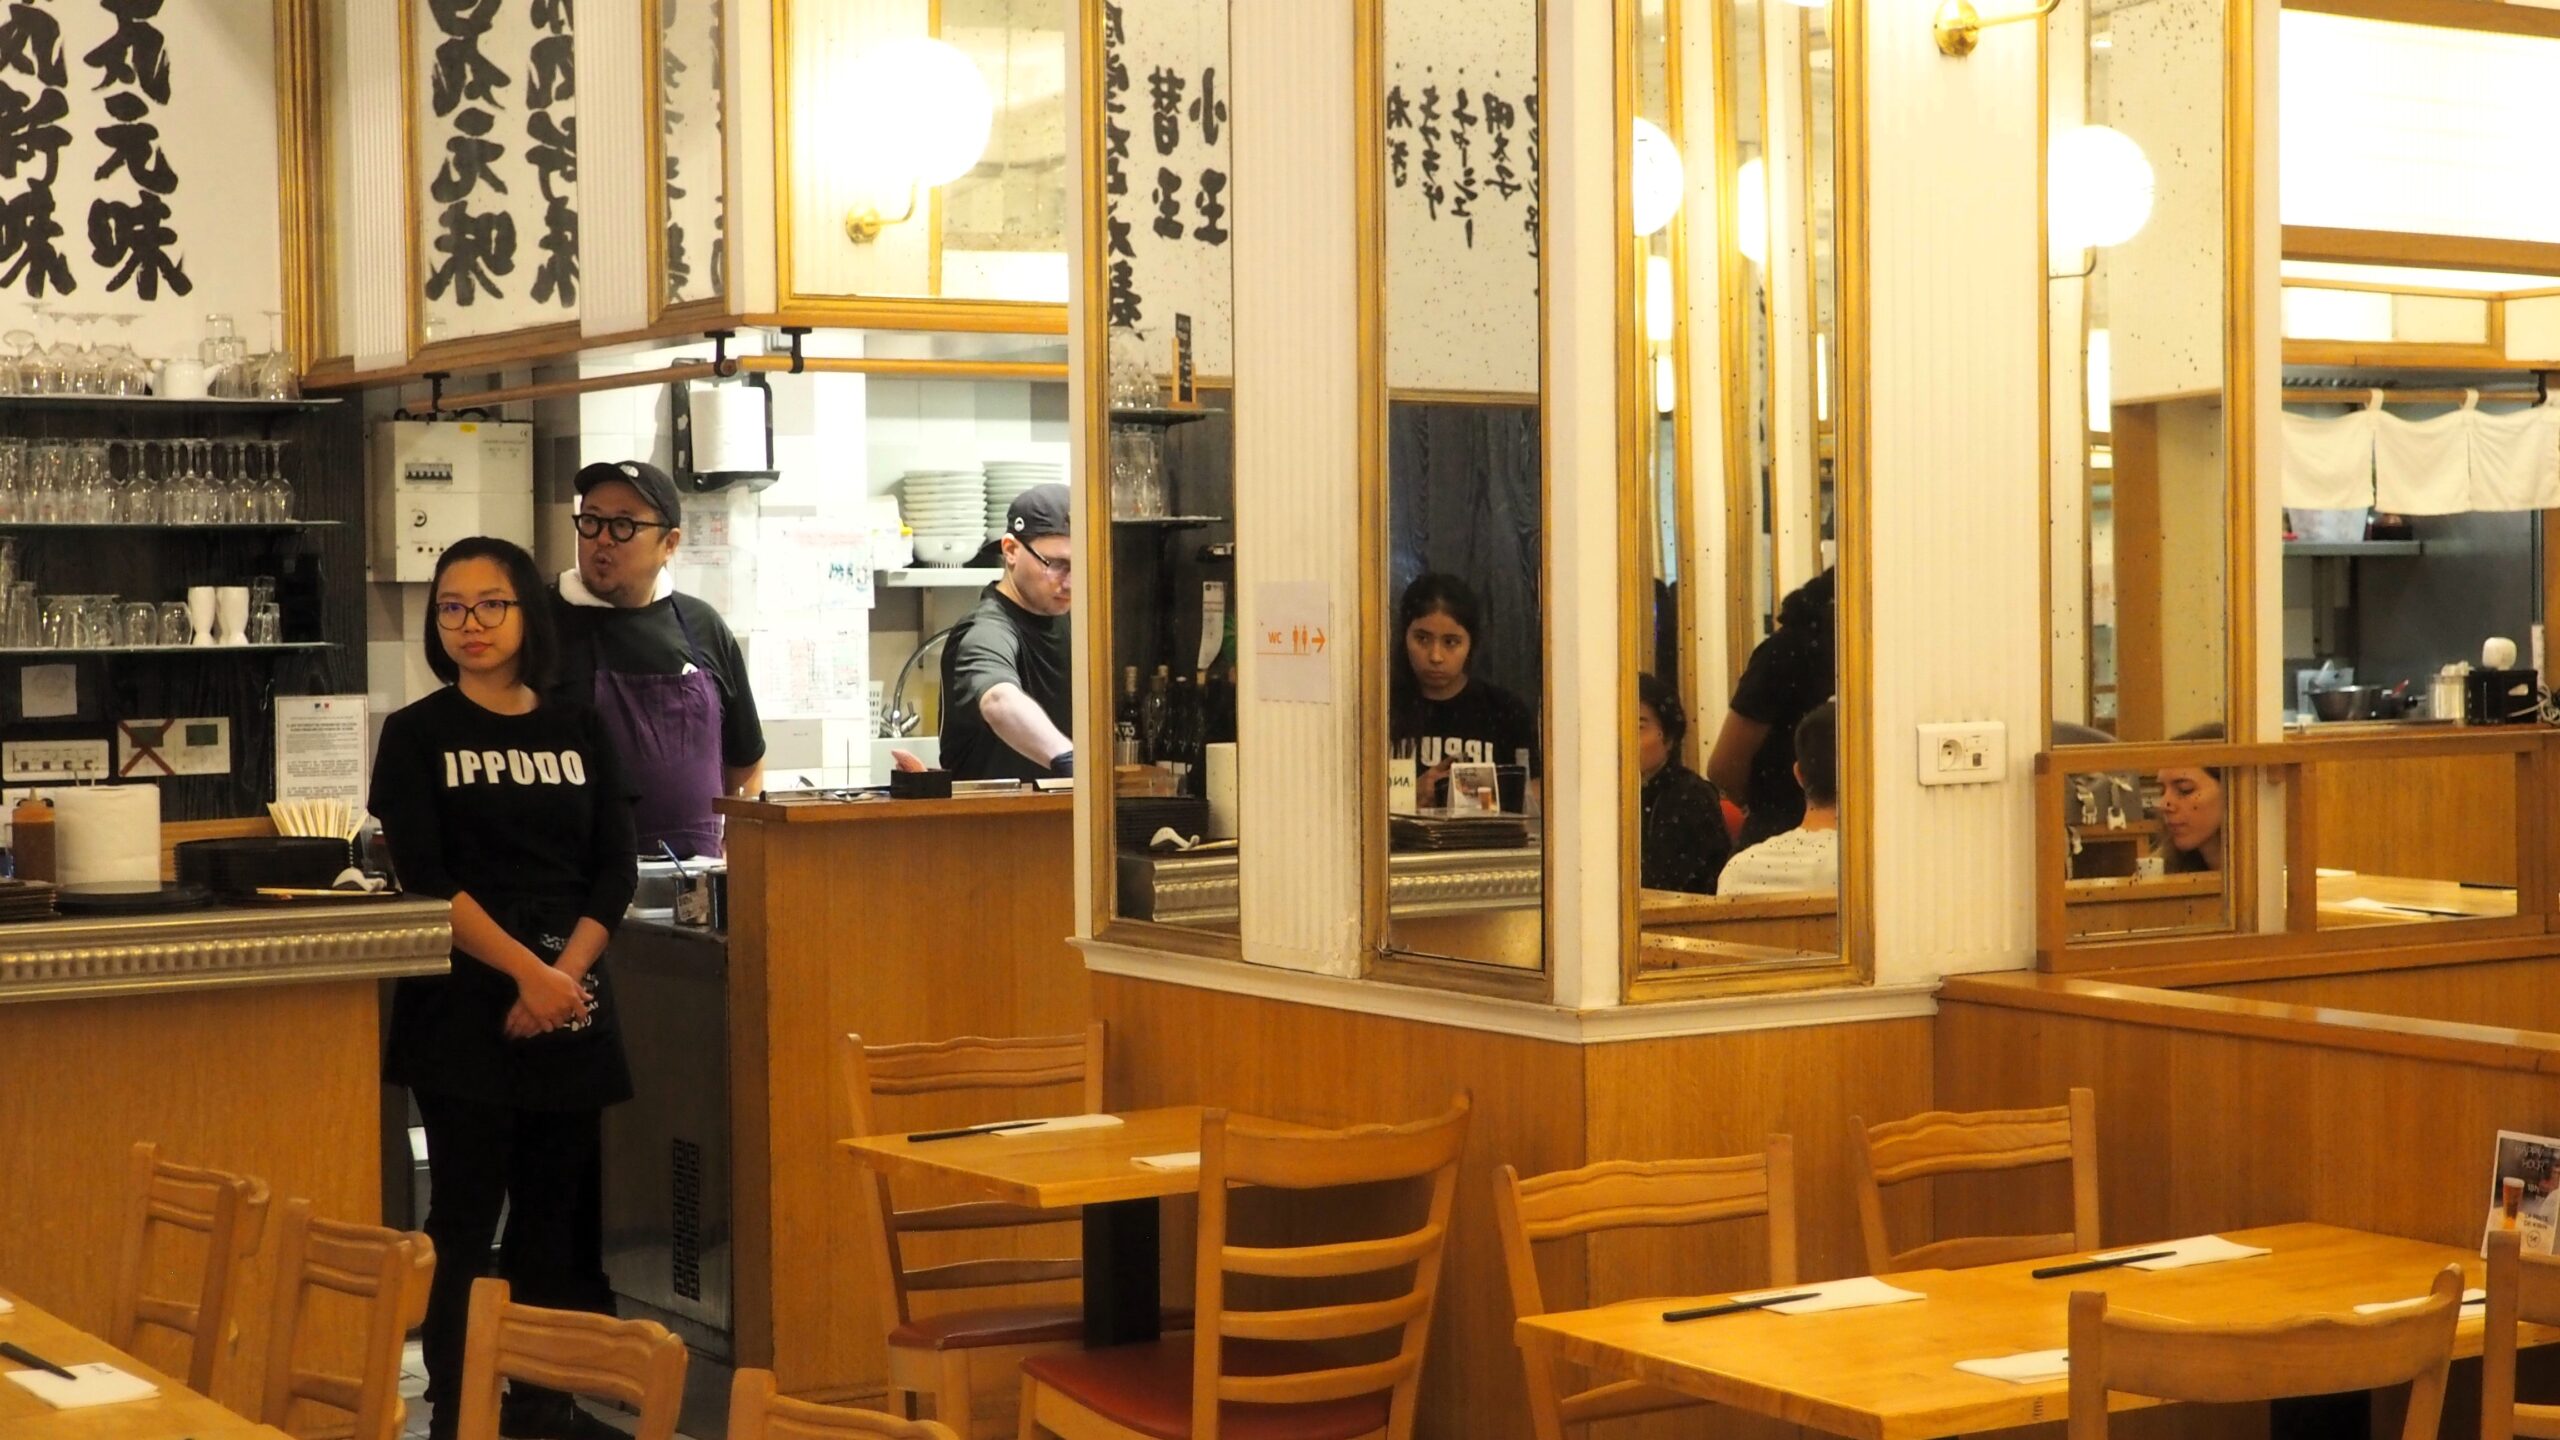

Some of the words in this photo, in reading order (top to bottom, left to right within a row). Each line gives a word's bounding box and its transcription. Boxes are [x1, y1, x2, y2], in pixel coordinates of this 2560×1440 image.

[0, 0, 77, 299] 丸新味
[83, 0, 192, 301] 丸元味
[1267, 631, 1283, 644] WC
[444, 749, 586, 787] IPPUDO
